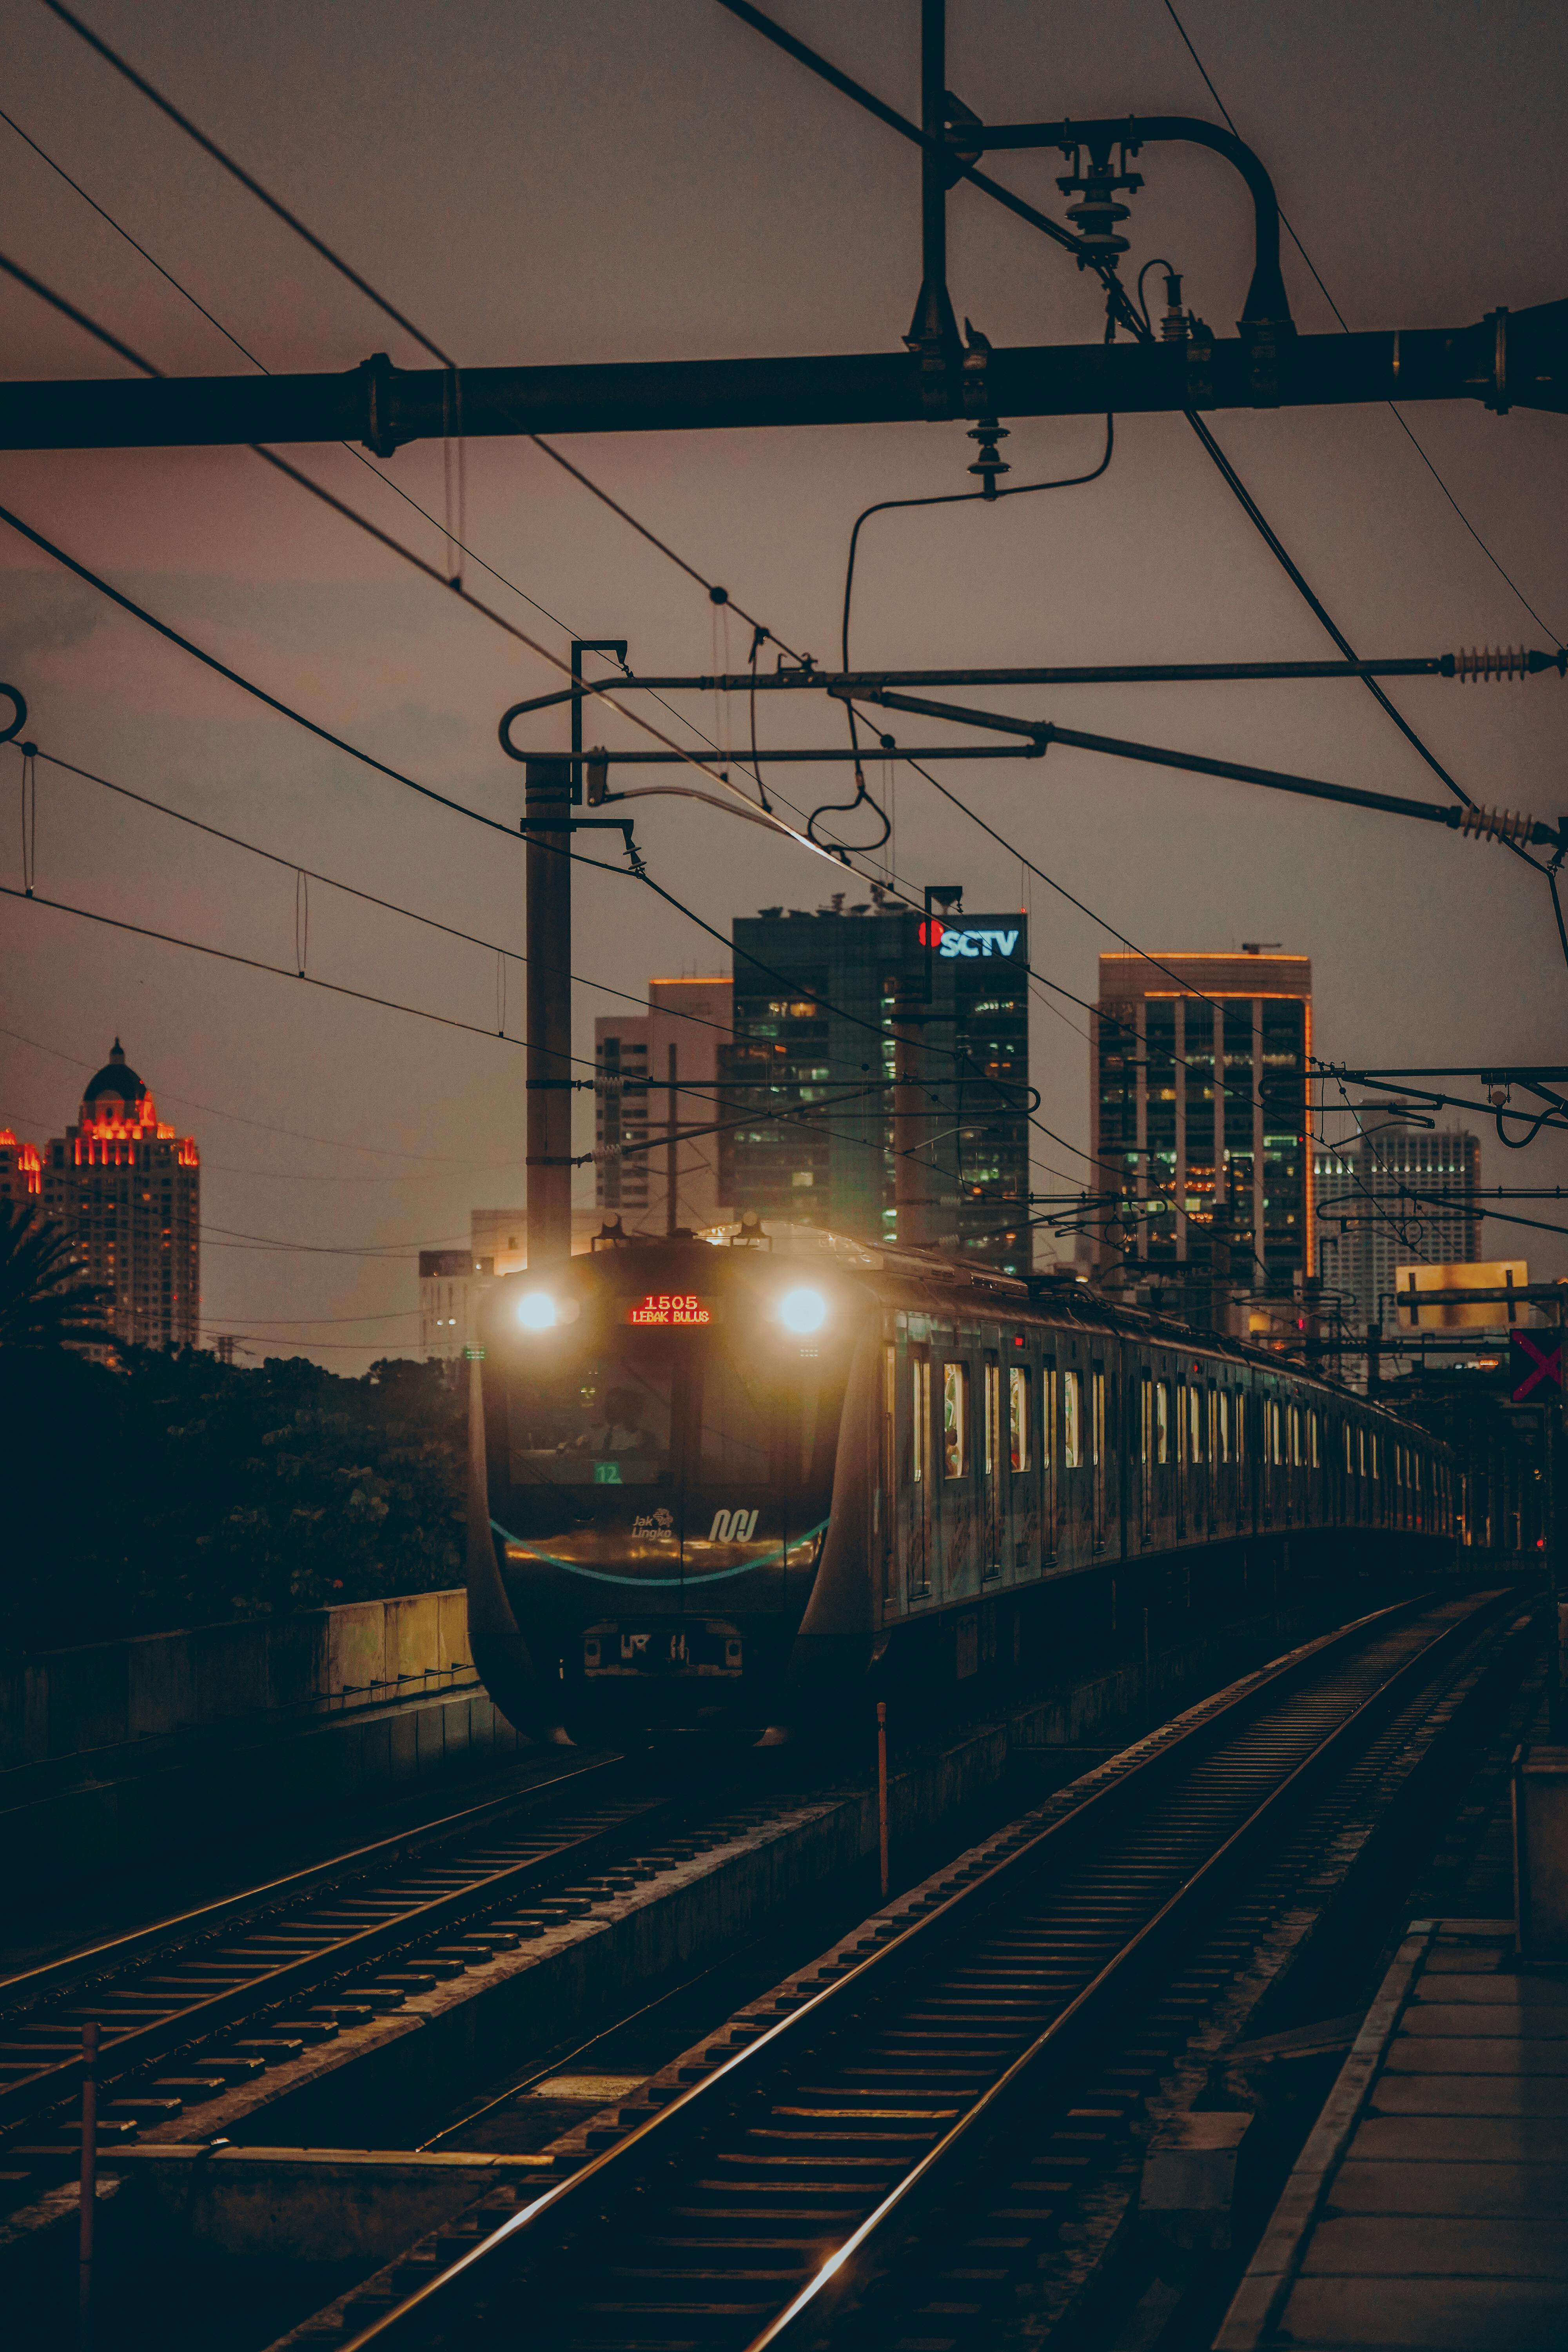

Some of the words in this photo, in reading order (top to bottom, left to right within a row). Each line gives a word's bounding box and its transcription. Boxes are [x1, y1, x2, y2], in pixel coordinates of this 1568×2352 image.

[939, 929, 1019, 957] SCTV
[644, 1296, 697, 1309] 1505
[633, 1311, 669, 1322] LEBAK
[673, 1311, 709, 1322] BULUS
[597, 1466, 622, 1484] 12
[632, 1515, 653, 1526] Jak
[632, 1527, 672, 1541] Lingko
